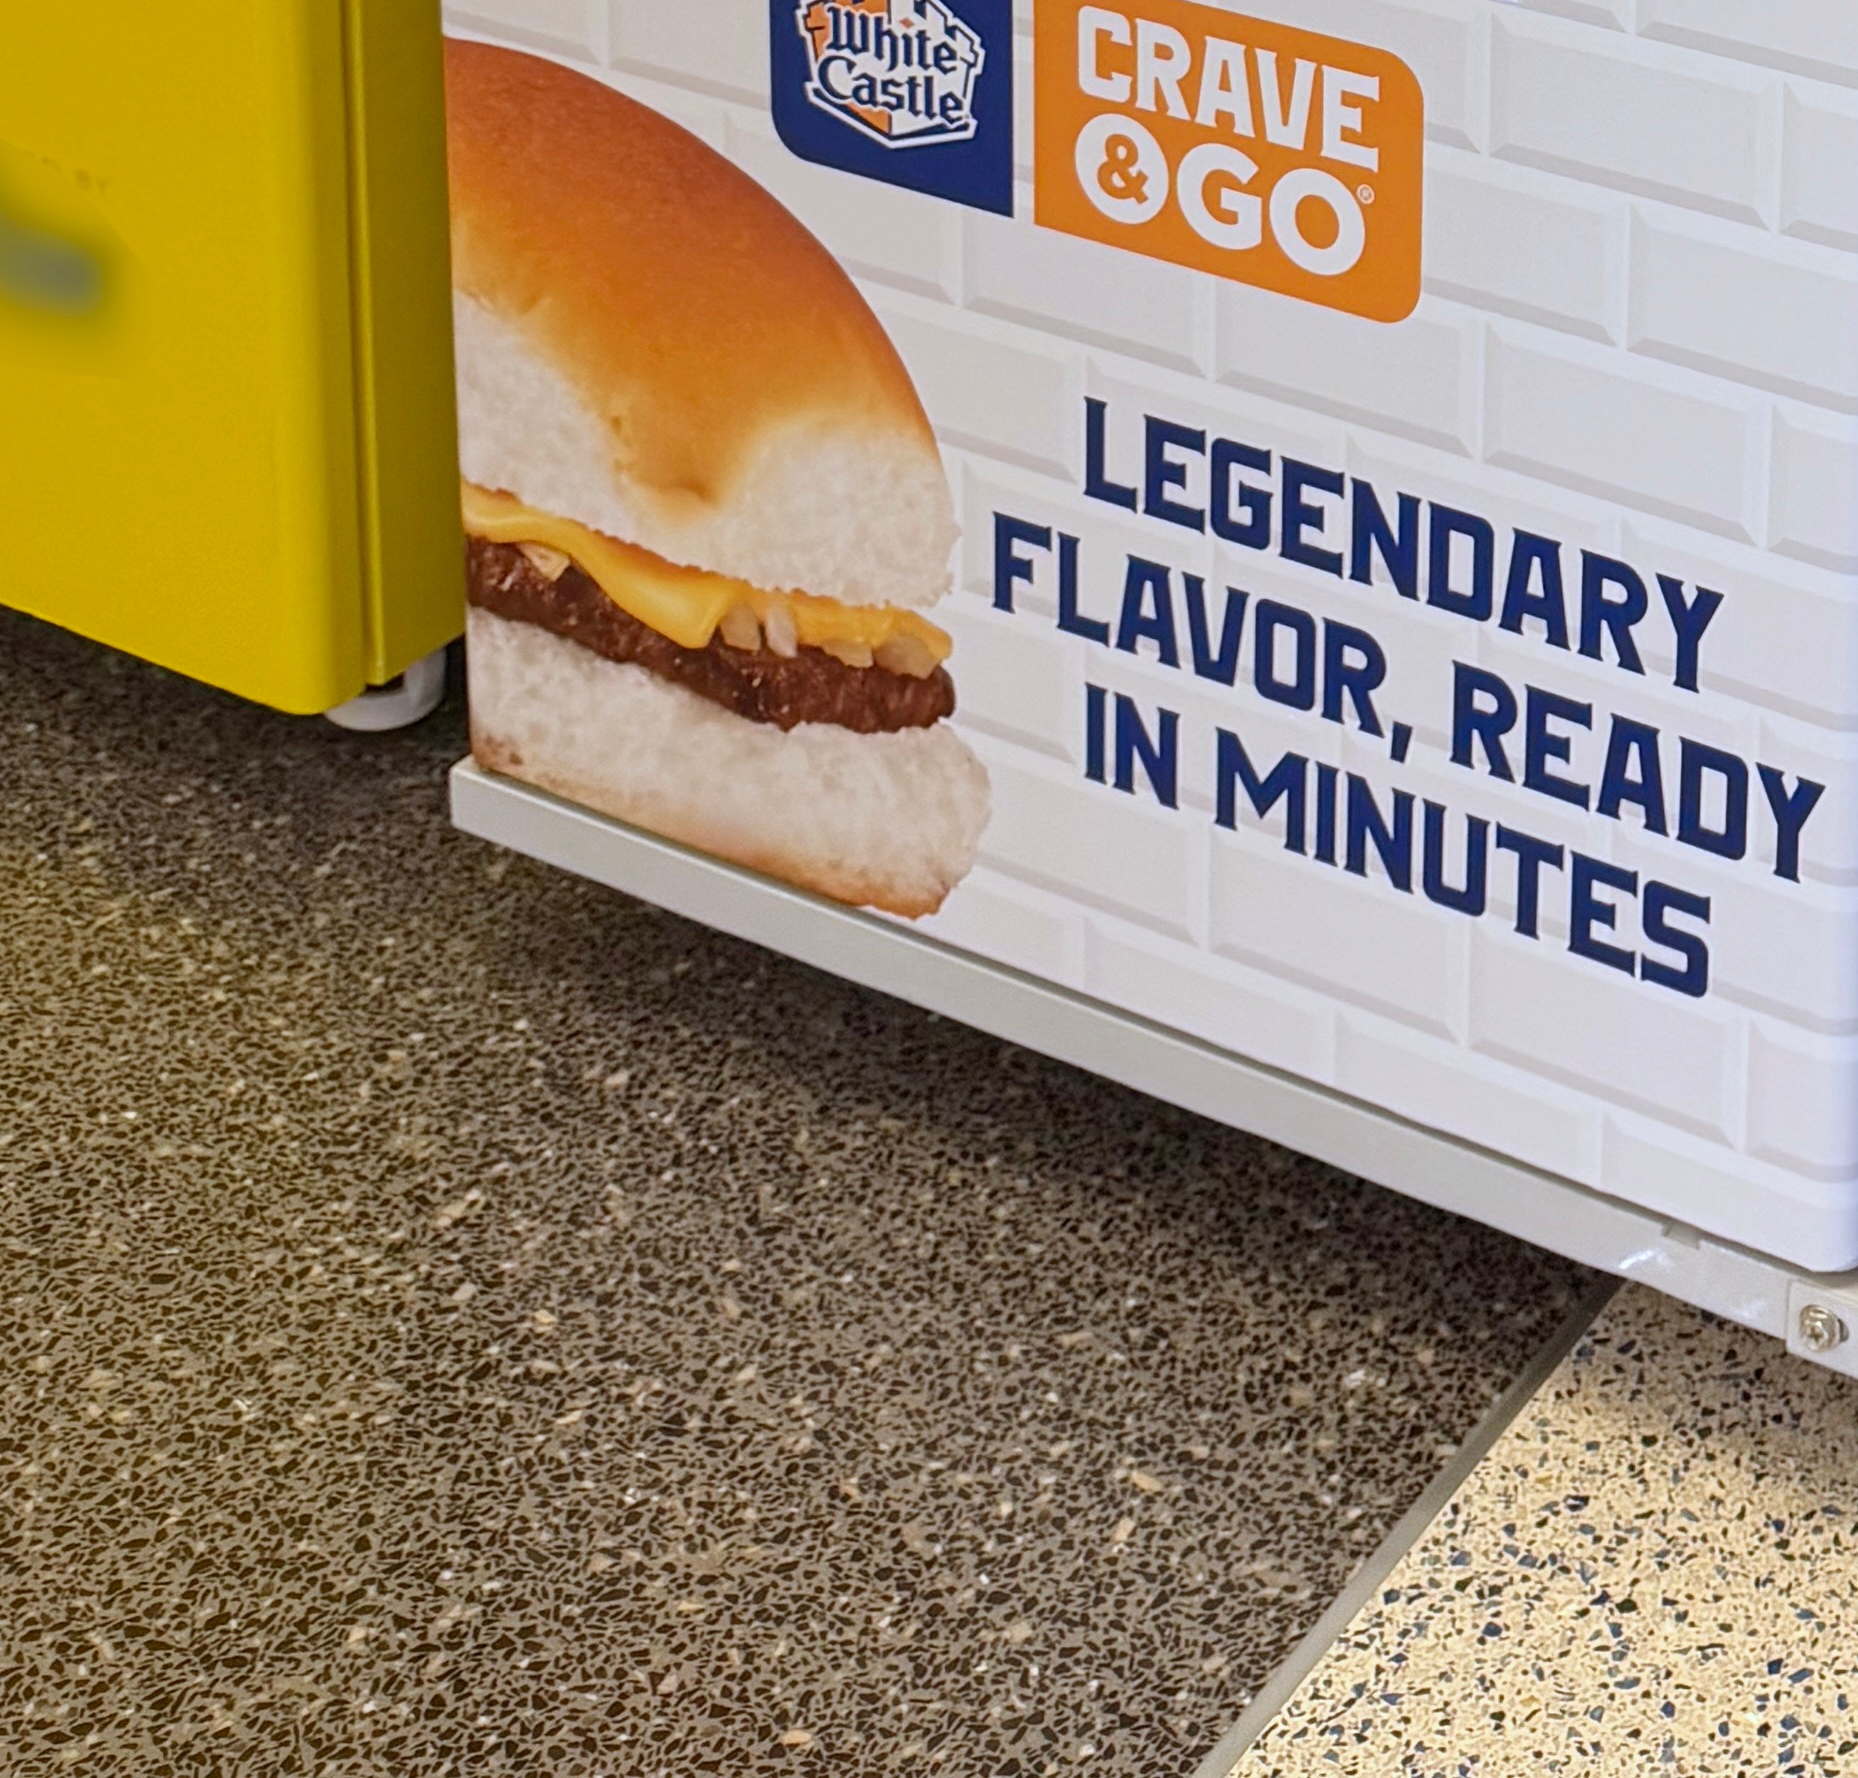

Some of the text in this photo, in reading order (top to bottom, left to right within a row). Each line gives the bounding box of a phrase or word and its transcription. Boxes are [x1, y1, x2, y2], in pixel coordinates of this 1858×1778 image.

[818, 55, 964, 125] Castle
[826, 5, 957, 75] White
[1078, 5, 1379, 173] CRAVE
[1082, 395, 1724, 693] LEGENDARY
[991, 511, 1825, 884] FLAVOR, READY
[1084, 681, 1711, 999] IN MINUTES
